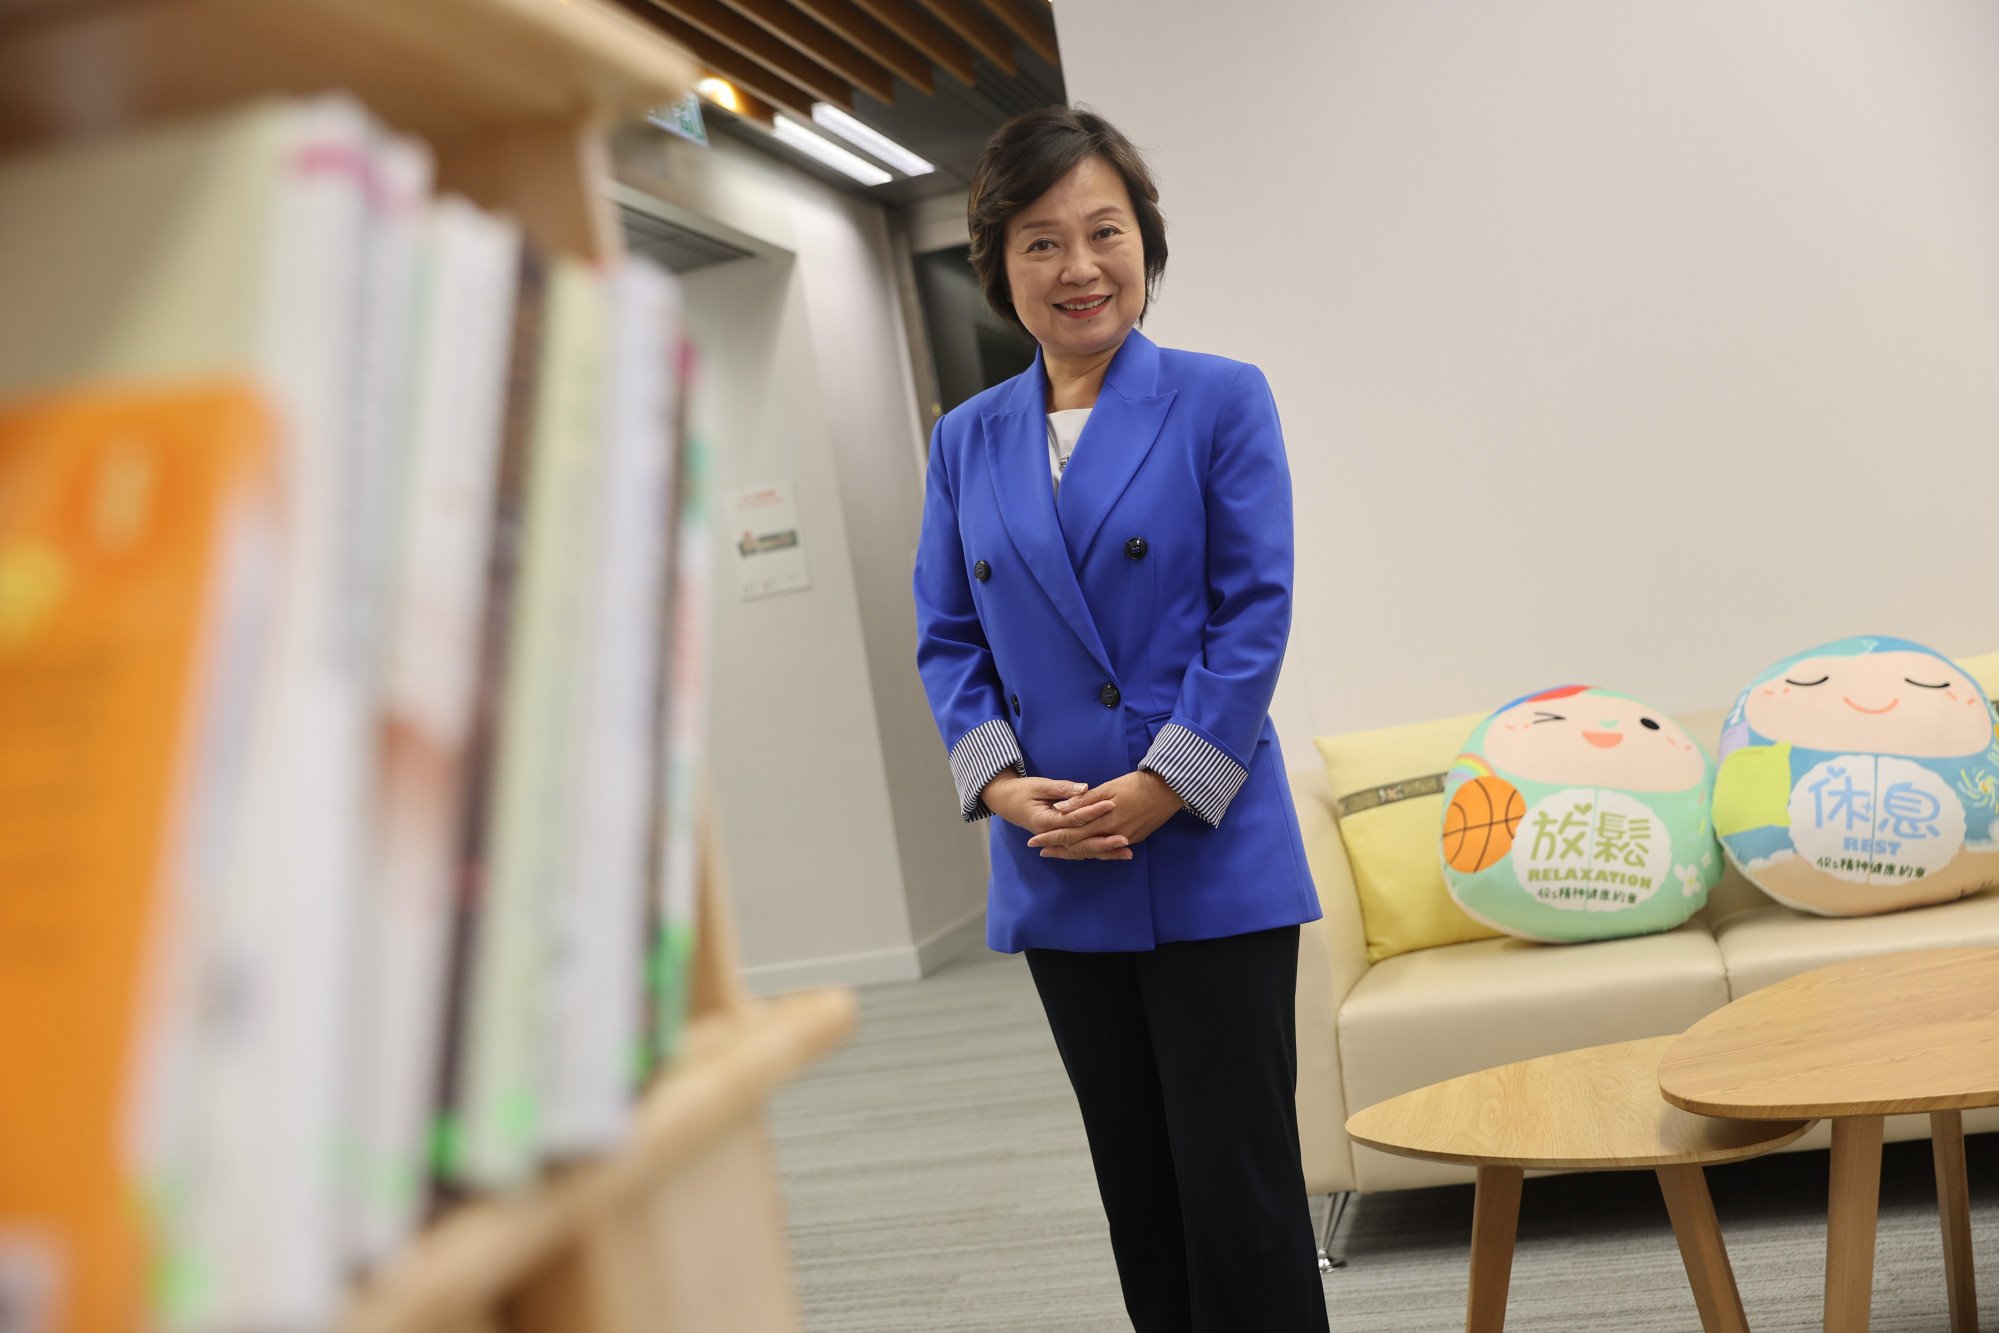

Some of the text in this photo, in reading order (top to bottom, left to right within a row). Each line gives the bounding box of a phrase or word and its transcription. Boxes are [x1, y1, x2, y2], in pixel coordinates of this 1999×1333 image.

[1808, 775, 1941, 839] 休息
[1530, 808, 1651, 868] 放鬆
[1843, 837, 1901, 856] REST
[1527, 867, 1652, 889] RELAXATION
